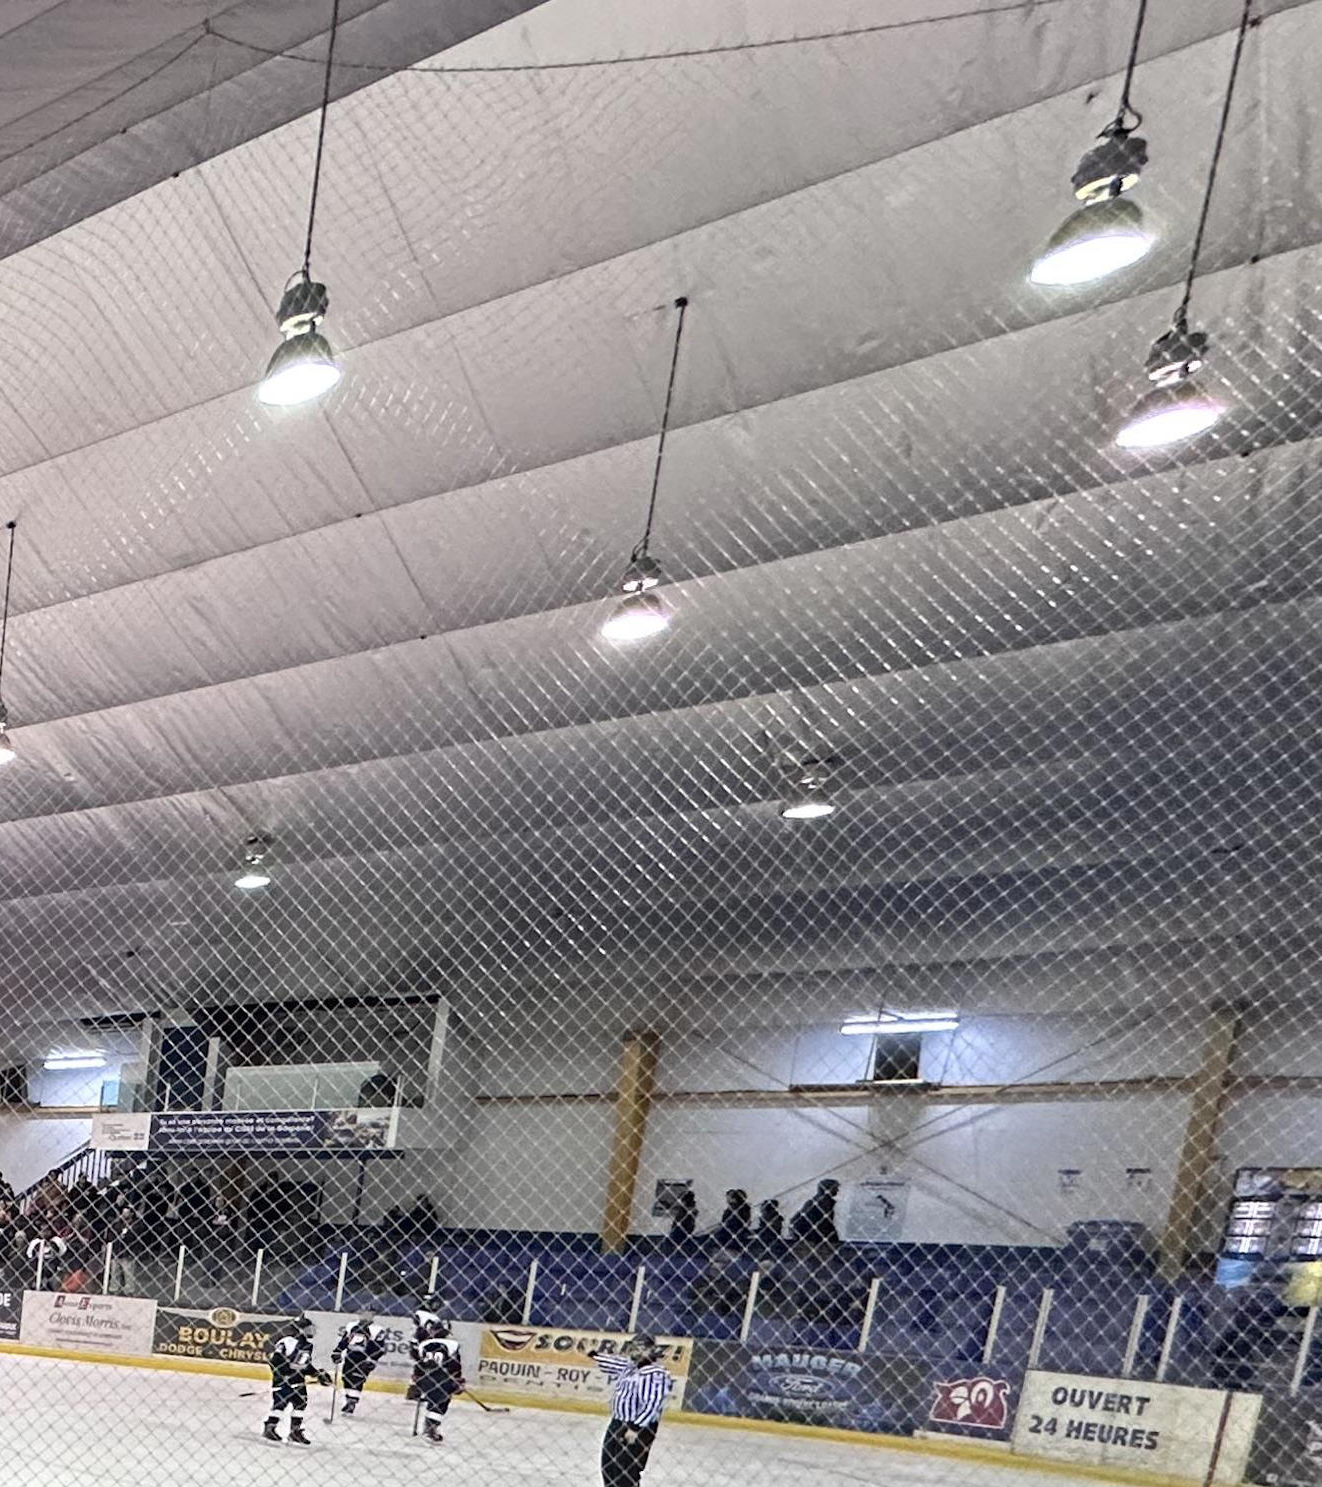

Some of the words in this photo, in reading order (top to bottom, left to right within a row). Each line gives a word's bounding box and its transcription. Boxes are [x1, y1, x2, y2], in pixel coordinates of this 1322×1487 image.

[179, 1325, 270, 1350] BOULAY
[159, 1342, 203, 1358] DODGE
[478, 1360, 541, 1378] PAQUIN
[557, 1368, 592, 1384] ROY
[752, 1353, 862, 1375] MAUGER
[781, 1377, 824, 1394] Ford
[1051, 1386, 1151, 1416] OUVERT
[1028, 1415, 1058, 1438] 24
[1065, 1420, 1160, 1450] HEURES
